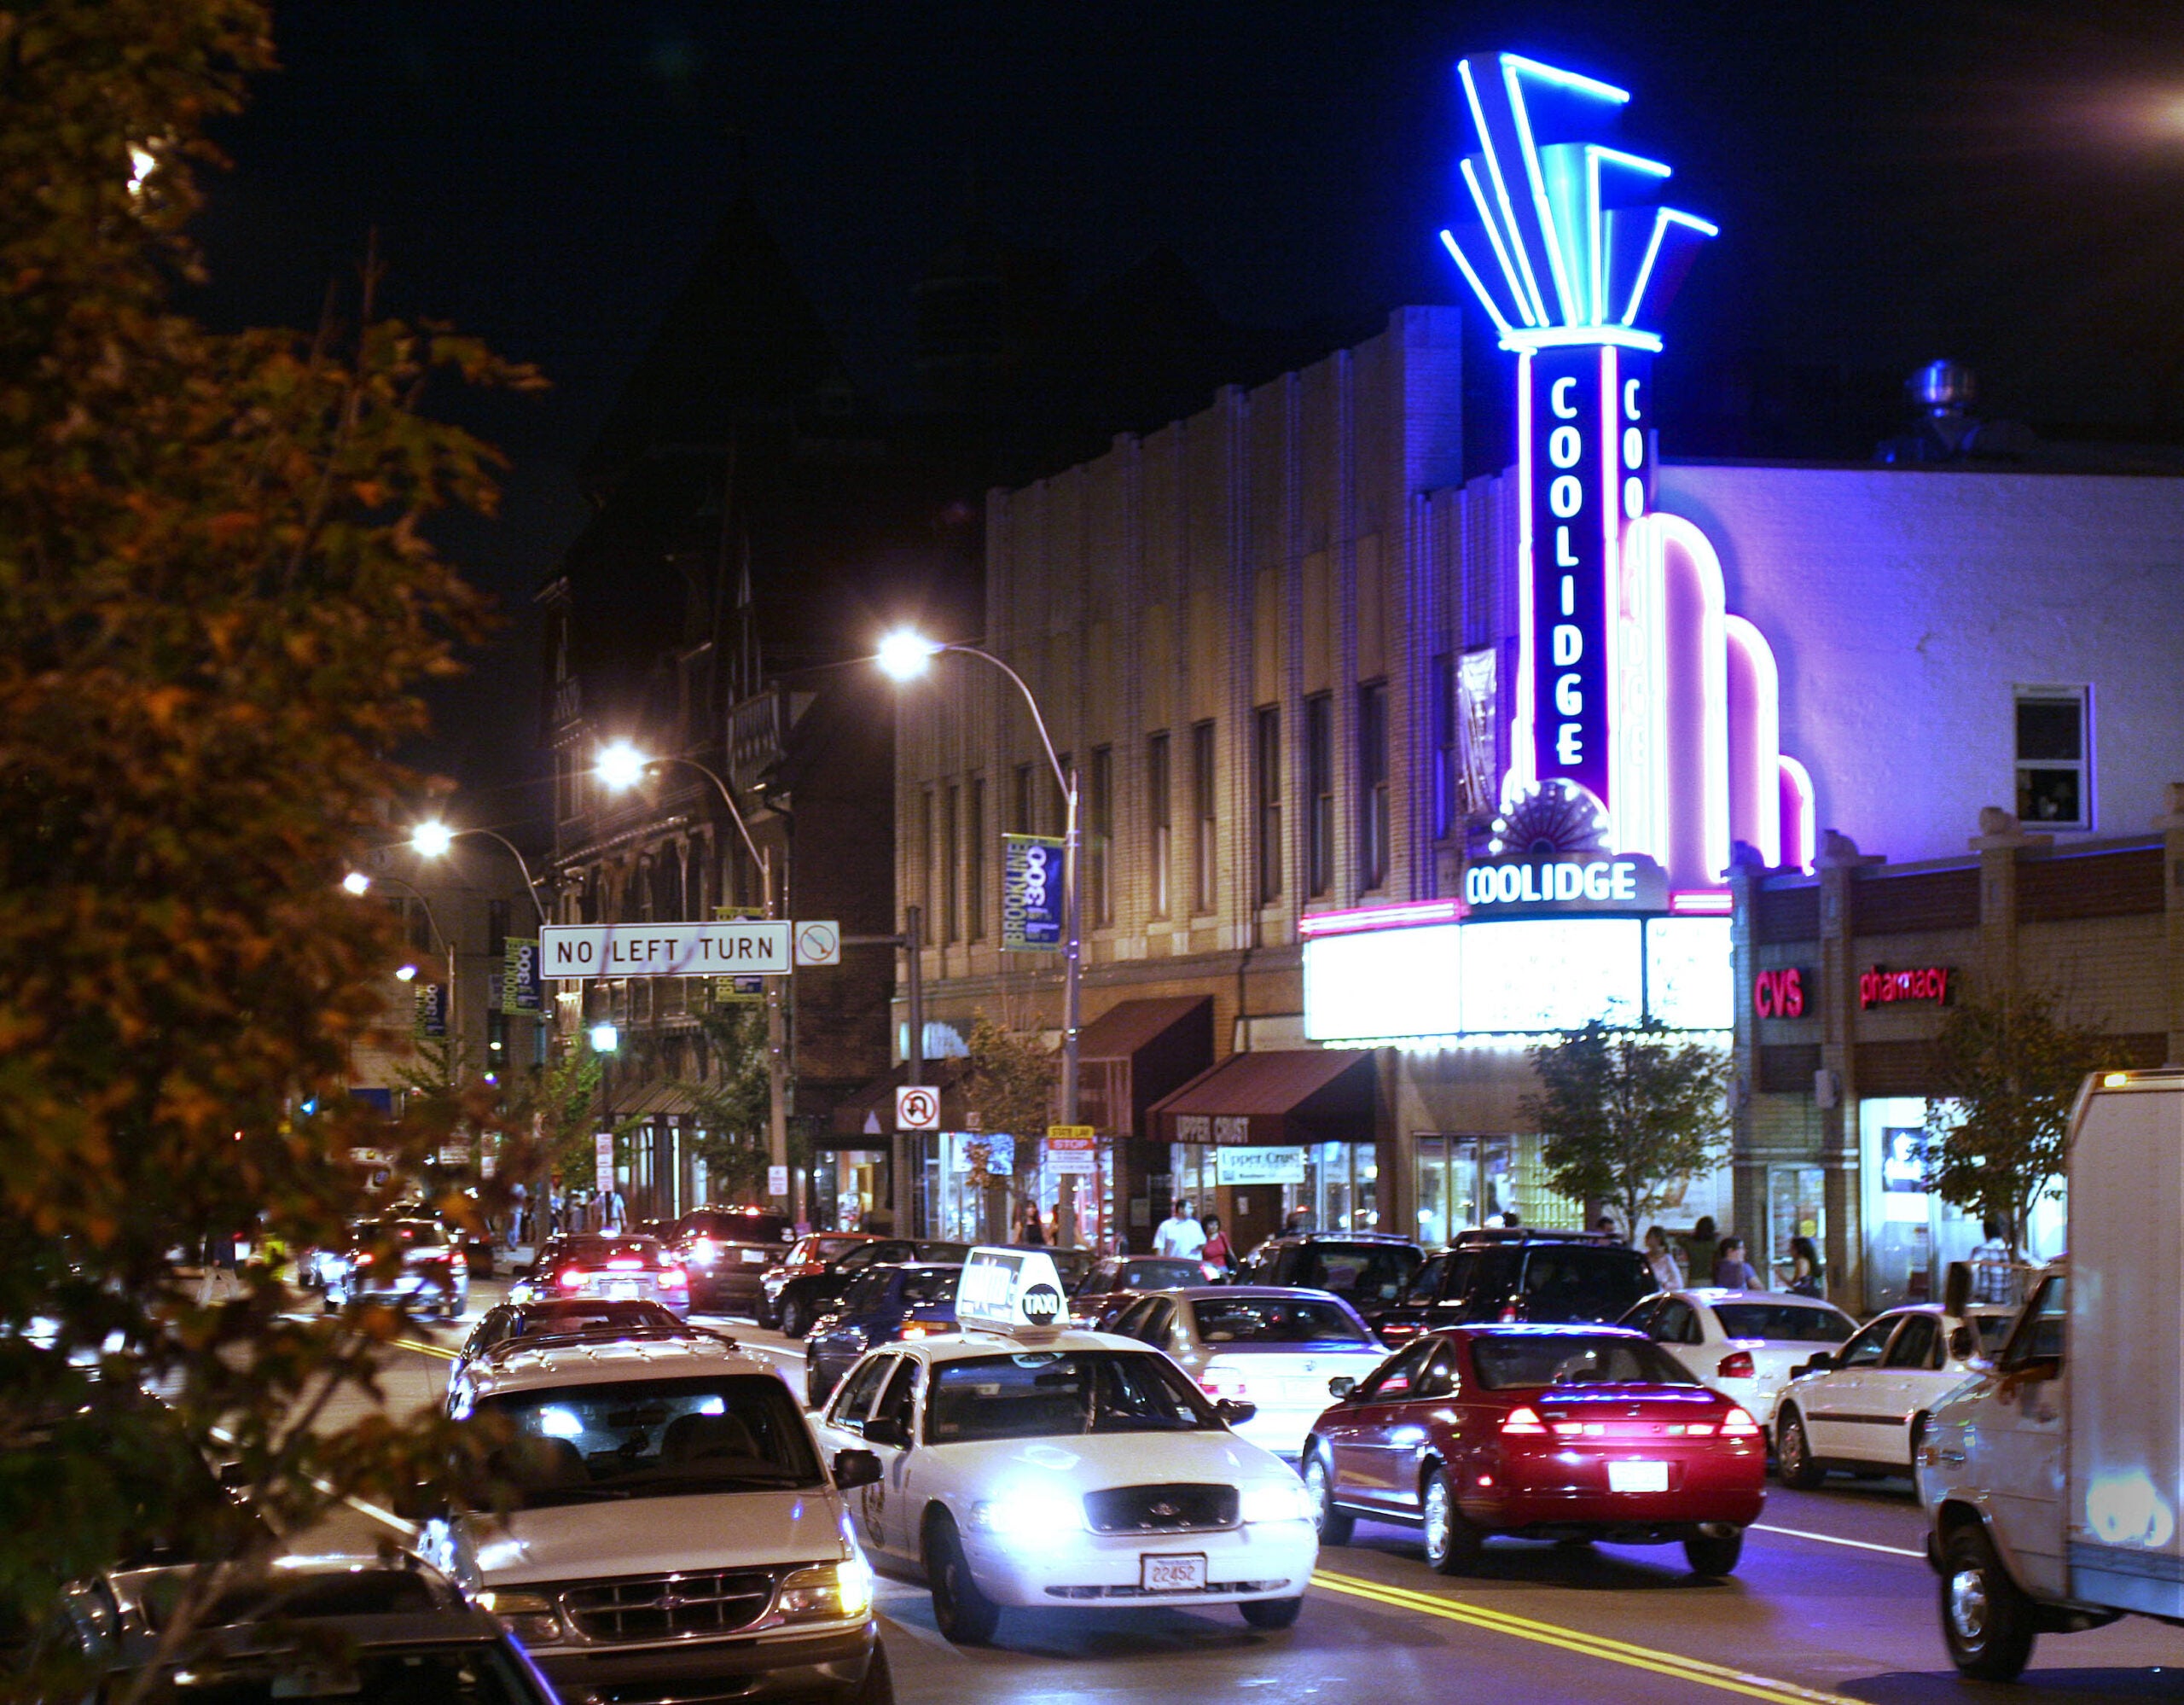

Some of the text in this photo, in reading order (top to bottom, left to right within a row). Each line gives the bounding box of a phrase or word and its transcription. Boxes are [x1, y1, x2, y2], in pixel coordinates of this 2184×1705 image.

[1549, 376, 1583, 765] COOLIDGE
[1003, 842, 1028, 940] BROOKLINE
[1466, 861, 1636, 905] COOLIDGE
[558, 937, 773, 963] NO LEFT TURN
[1754, 964, 1949, 1019] CVS pharmacy
[1054, 1139, 1089, 1149] STOP
[1024, 1293, 1058, 1314] TAXI
